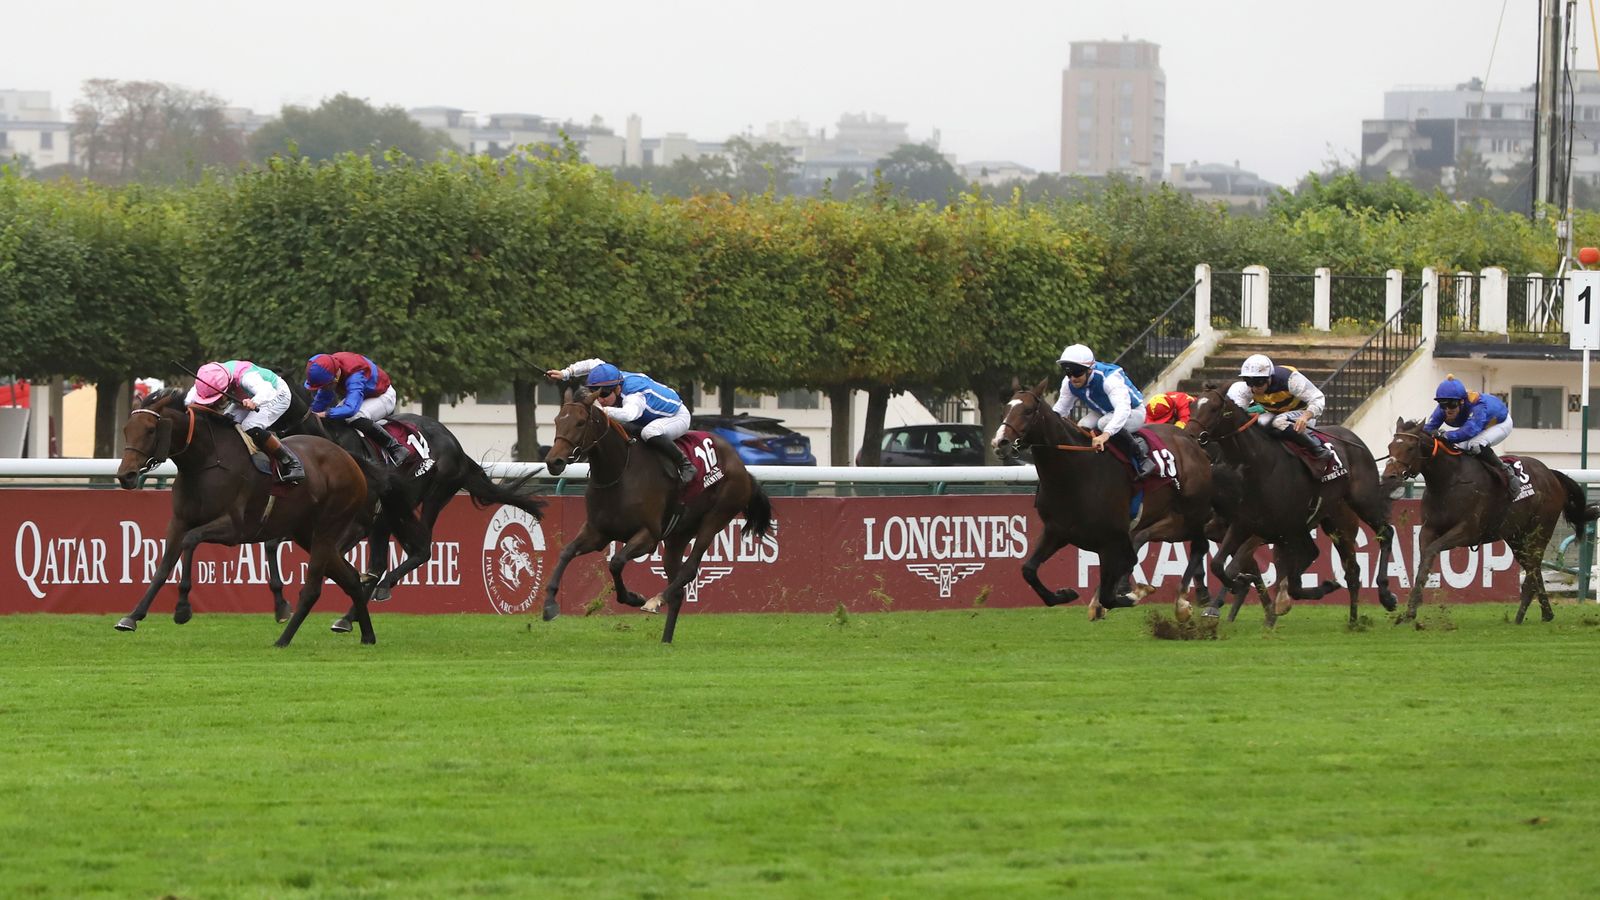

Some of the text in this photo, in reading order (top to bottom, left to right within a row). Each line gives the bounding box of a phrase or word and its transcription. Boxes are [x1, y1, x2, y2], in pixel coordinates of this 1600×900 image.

[1578, 286, 1591, 324] 1
[694, 438, 717, 473] 16
[1152, 449, 1177, 477] 13
[1513, 460, 1530, 484] 3
[863, 516, 1028, 560] LONGINES
[15, 520, 109, 598] QATAR
[198, 561, 217, 584] DE
